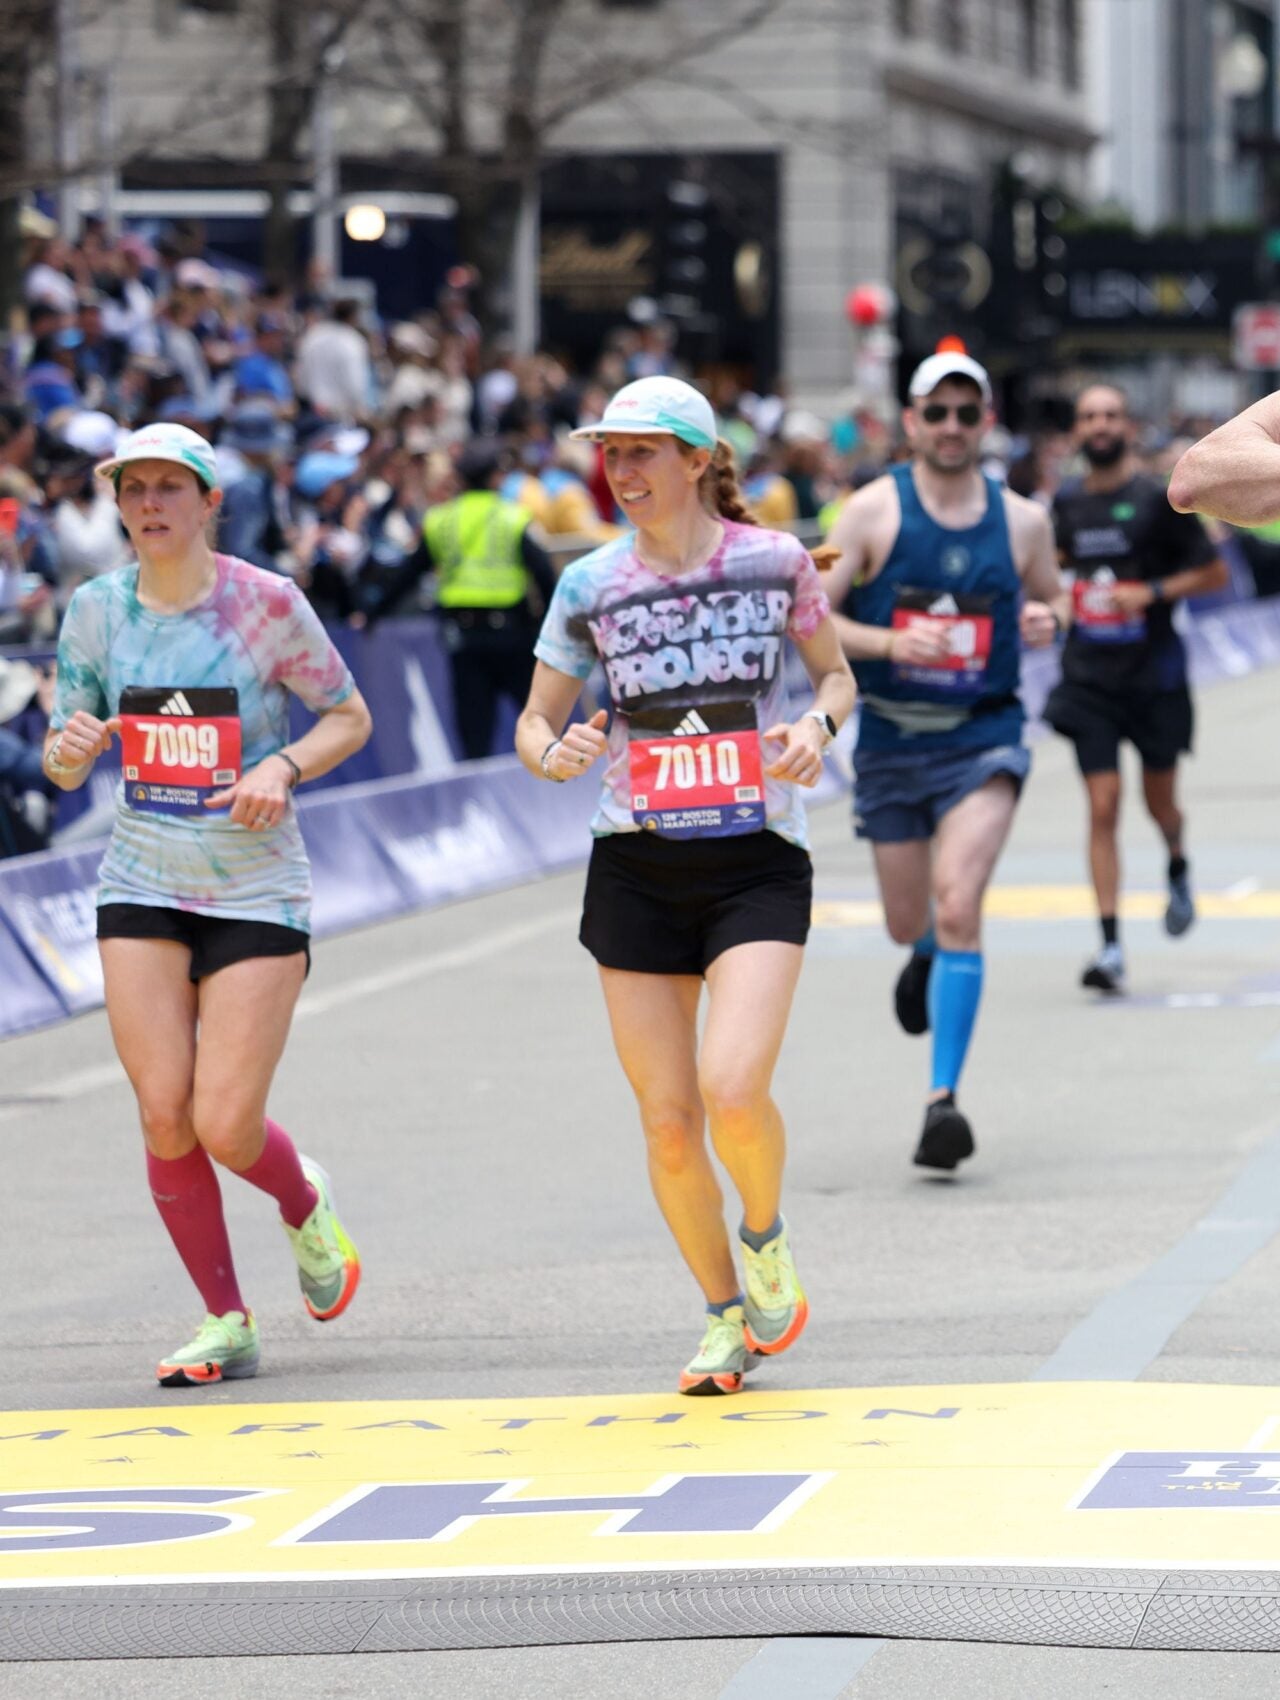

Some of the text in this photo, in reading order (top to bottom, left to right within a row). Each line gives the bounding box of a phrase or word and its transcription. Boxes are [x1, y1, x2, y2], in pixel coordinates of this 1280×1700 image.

[136, 722, 219, 769] 7009
[648, 740, 740, 791] 7010
[663, 818, 721, 829] MARATHON
